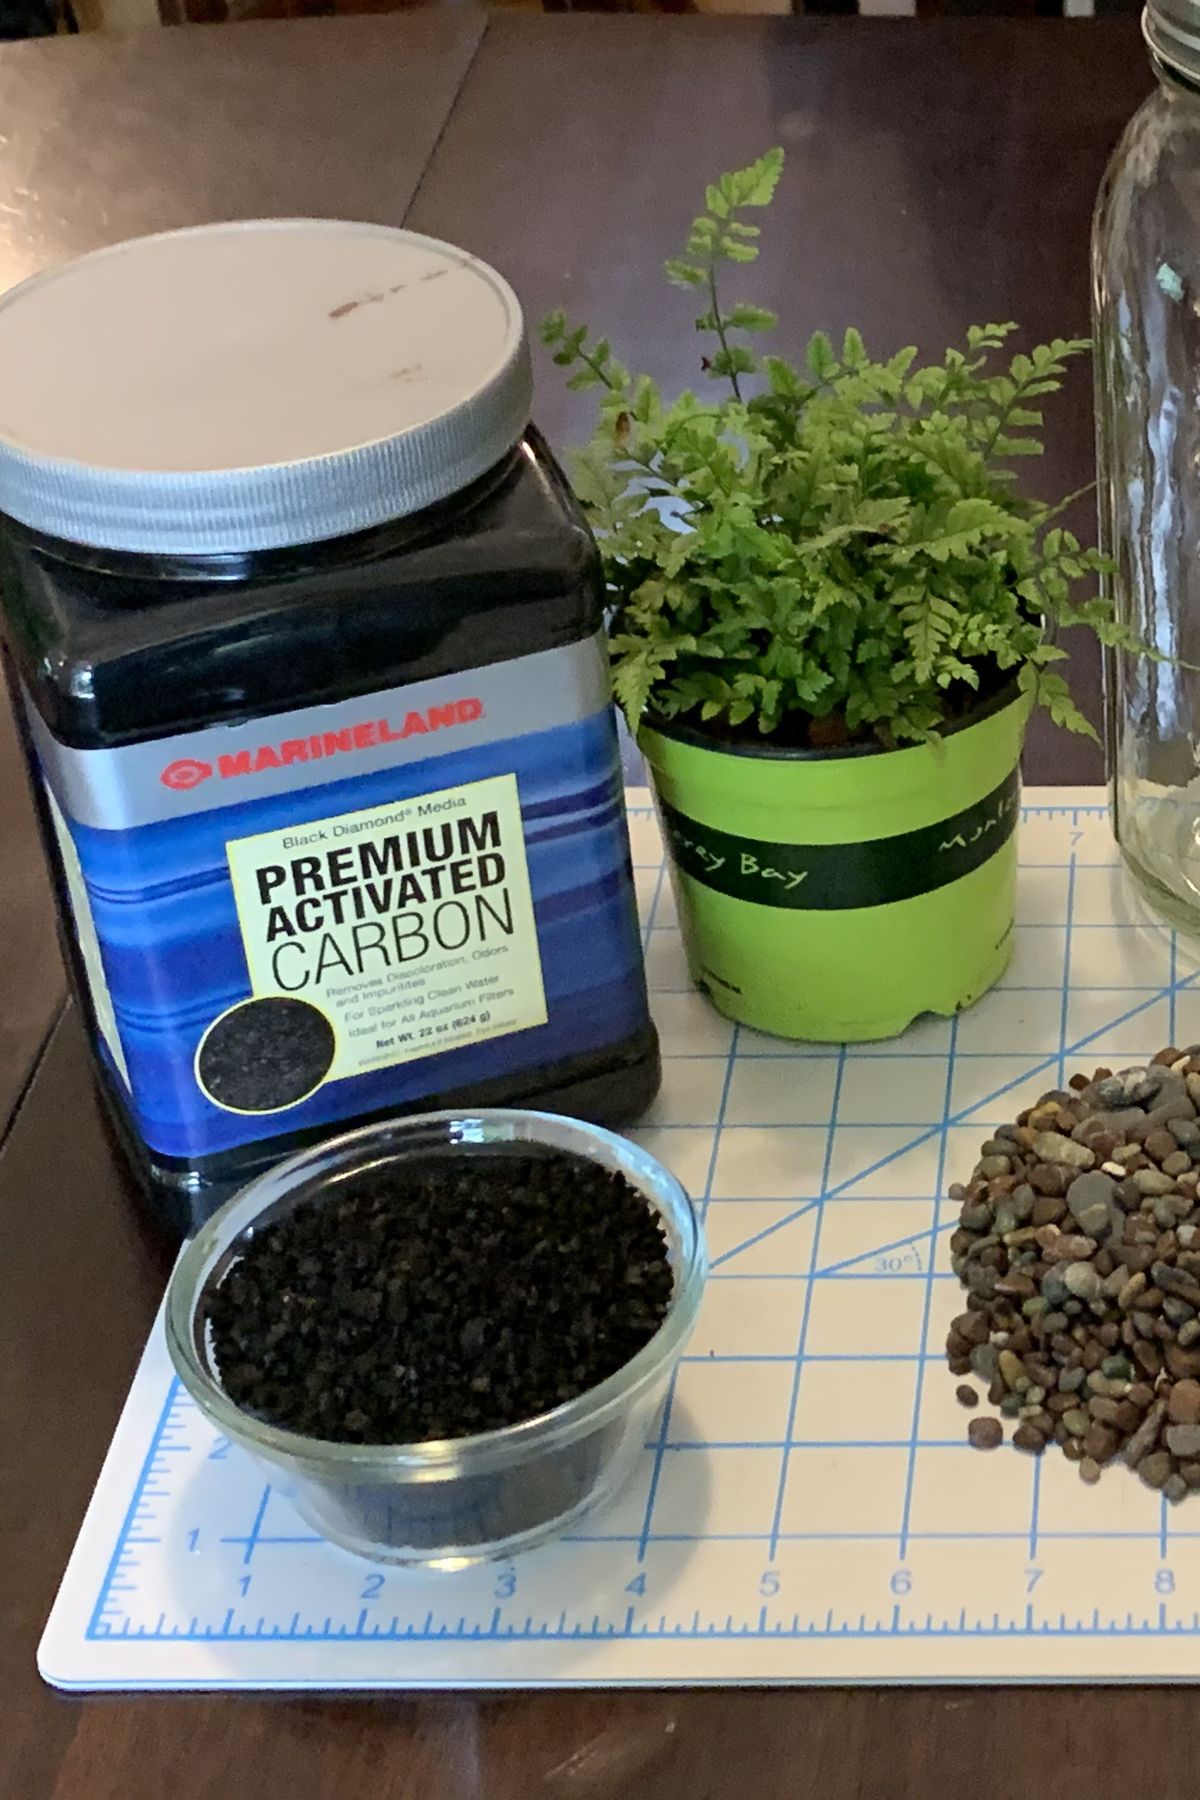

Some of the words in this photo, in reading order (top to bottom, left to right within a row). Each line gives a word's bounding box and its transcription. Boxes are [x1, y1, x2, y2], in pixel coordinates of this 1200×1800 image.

[217, 697, 484, 779] MARINELAND
[281, 829, 328, 850] Black
[416, 796, 468, 818] Media
[1069, 831, 1084, 846] 7
[256, 810, 502, 905] PREMIUM
[739, 851, 808, 891] Bay
[266, 852, 506, 943] ACTIVATED
[271, 887, 514, 992] CARBON
[326, 978, 384, 999] Removes
[471, 944, 510, 961] Odors
[427, 985, 463, 1001] Clean
[465, 975, 500, 991] Water
[419, 998, 477, 1020] Aquarium
[376, 1036, 396, 1049] Net
[208, 1436, 232, 1460] 2
[188, 1527, 201, 1553] 1
[238, 1574, 252, 1597] 1
[360, 1573, 386, 1598] 2
[494, 1573, 517, 1597] 3
[625, 1573, 648, 1597] 4
[758, 1571, 781, 1597] 5
[890, 1570, 912, 1595] 6
[1023, 1569, 1043, 1593] 7
[1154, 1569, 1176, 1594] 8
